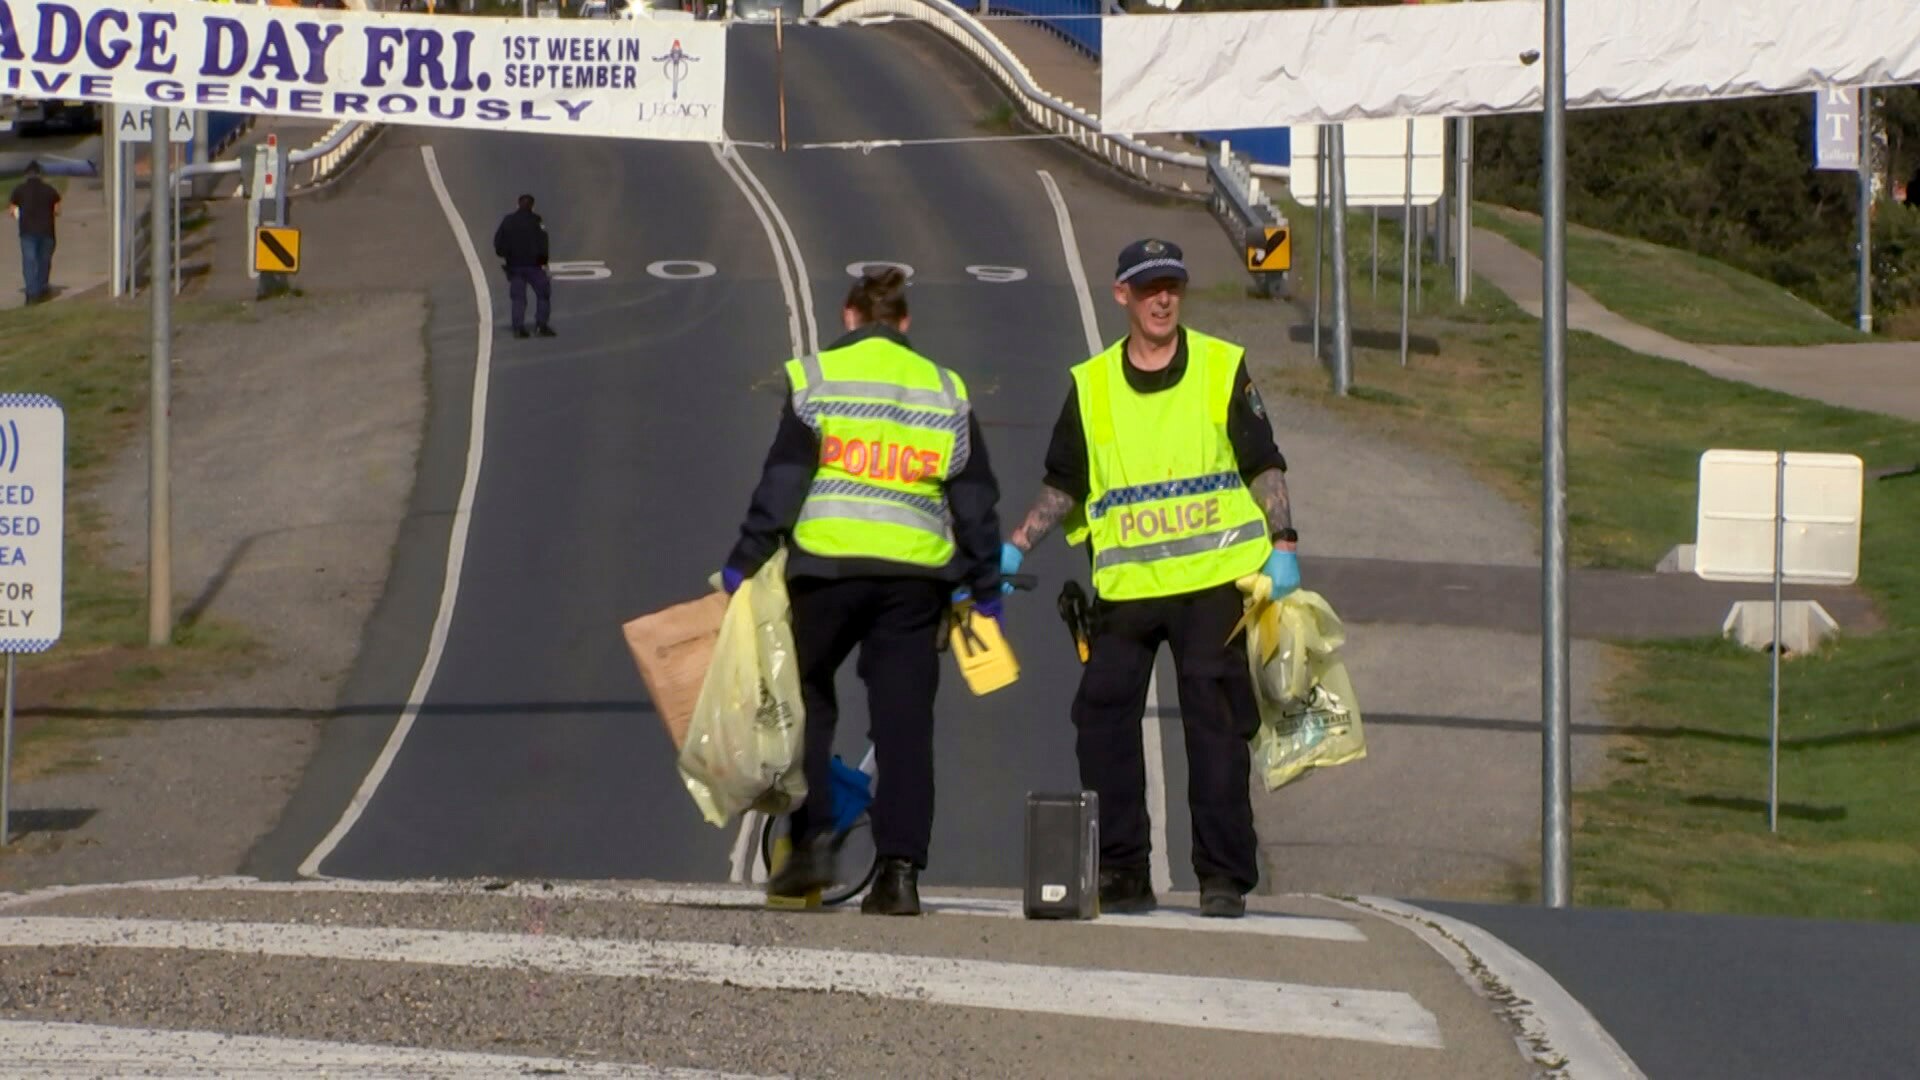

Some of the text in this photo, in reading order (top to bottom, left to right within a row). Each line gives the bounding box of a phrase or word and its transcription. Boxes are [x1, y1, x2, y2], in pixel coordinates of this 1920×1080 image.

[199, 16, 344, 85] DAY
[360, 26, 492, 93] FRI.
[502, 35, 640, 62] 1ST WEEK IN
[504, 63, 637, 89] SEPTEMBER
[8, 67, 593, 121] IVE GENEROUSLY
[120, 109, 192, 131] ARA
[637, 102, 713, 122] LEGACY
[821, 434, 942, 484] POLICE
[1119, 497, 1222, 541] POLICE
